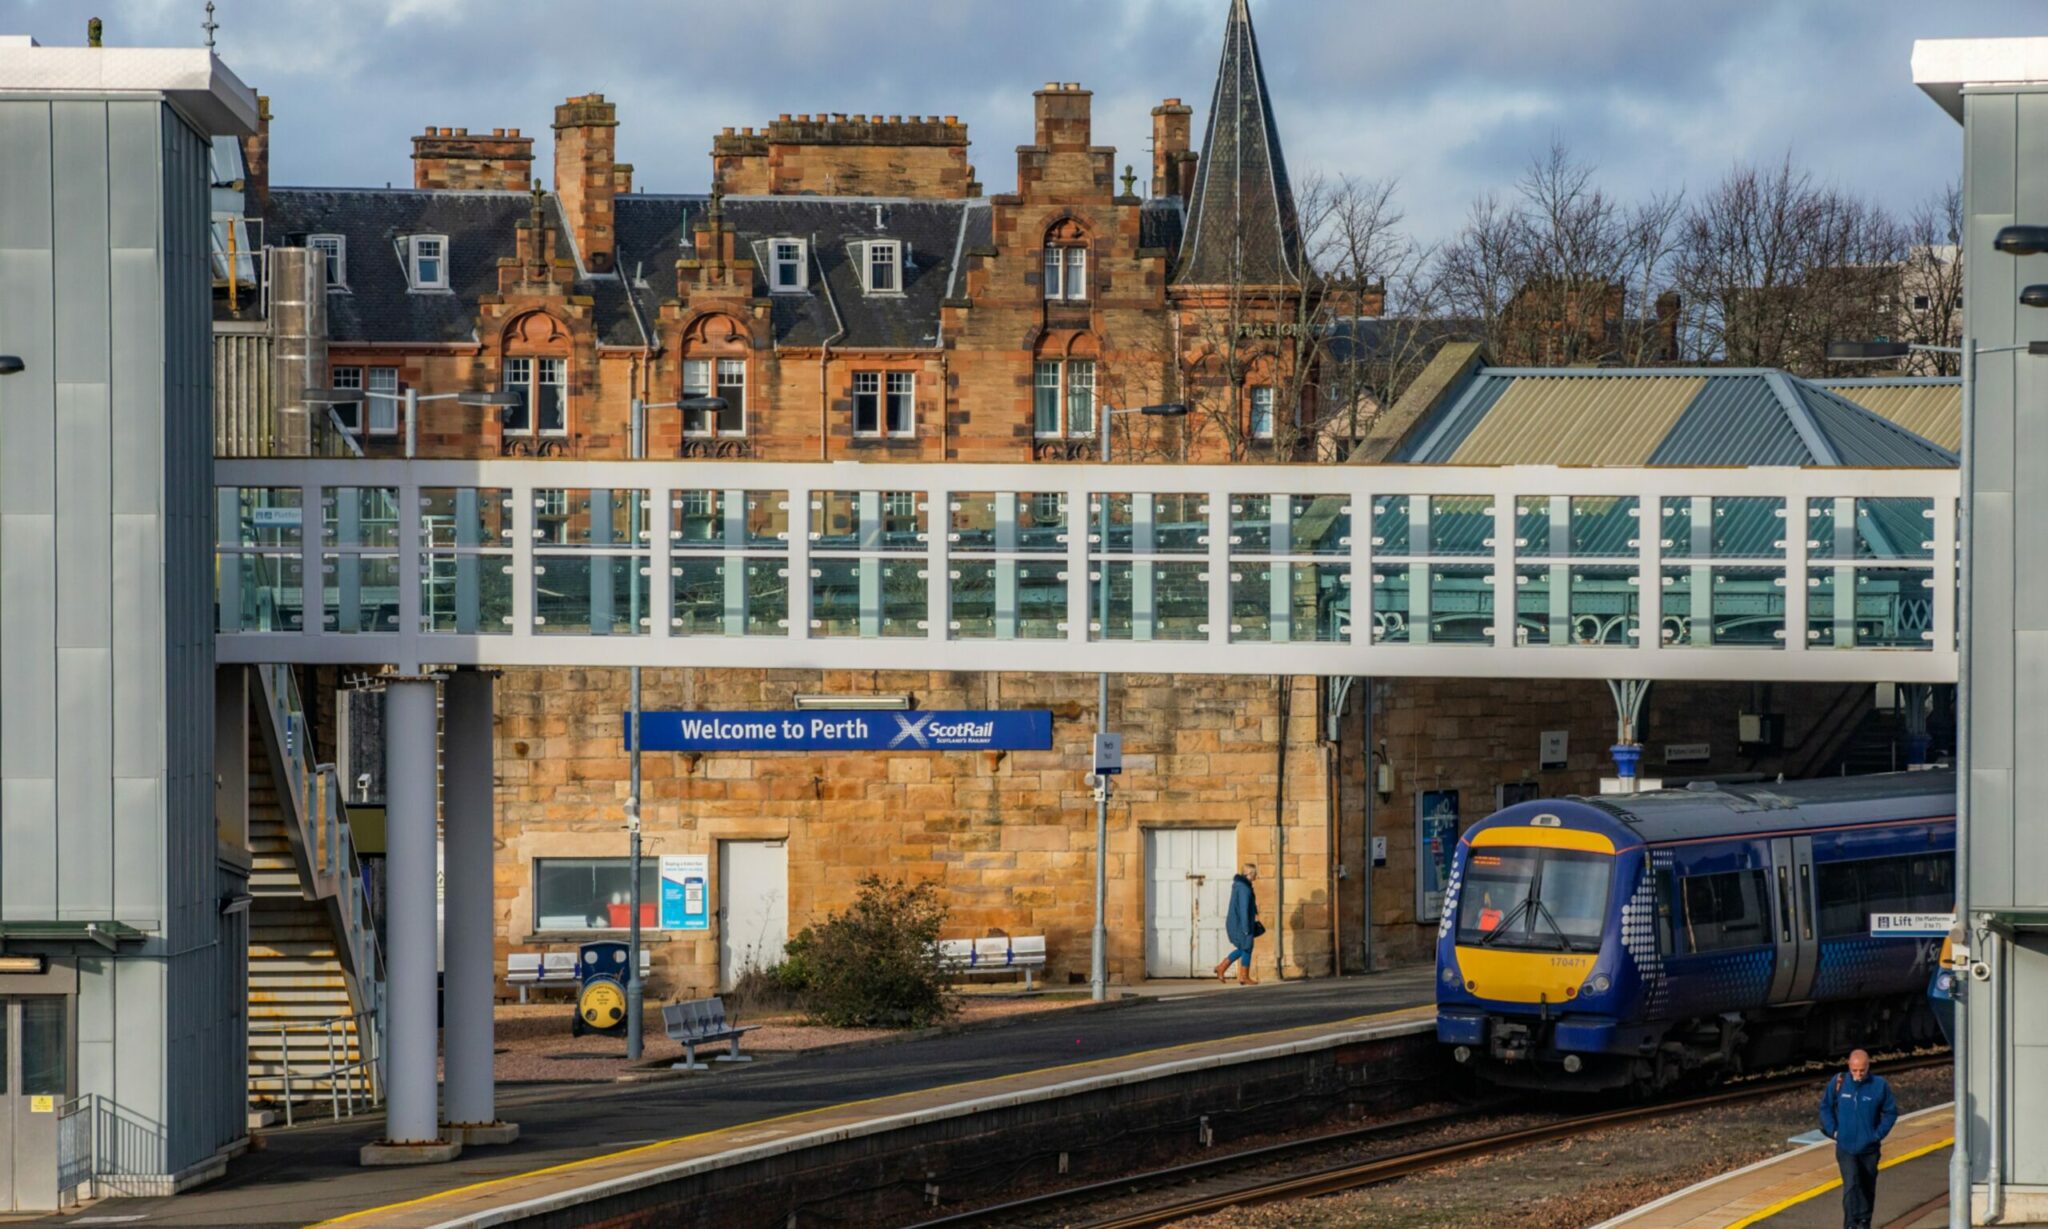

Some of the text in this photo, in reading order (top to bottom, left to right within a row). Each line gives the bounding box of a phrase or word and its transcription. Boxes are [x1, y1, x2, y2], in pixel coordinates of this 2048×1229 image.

[681, 718, 868, 740] Welcome to Perth
[928, 721, 993, 737] ScotRail
[1893, 916, 1912, 927] Lift
[1551, 957, 1586, 968] 170471
